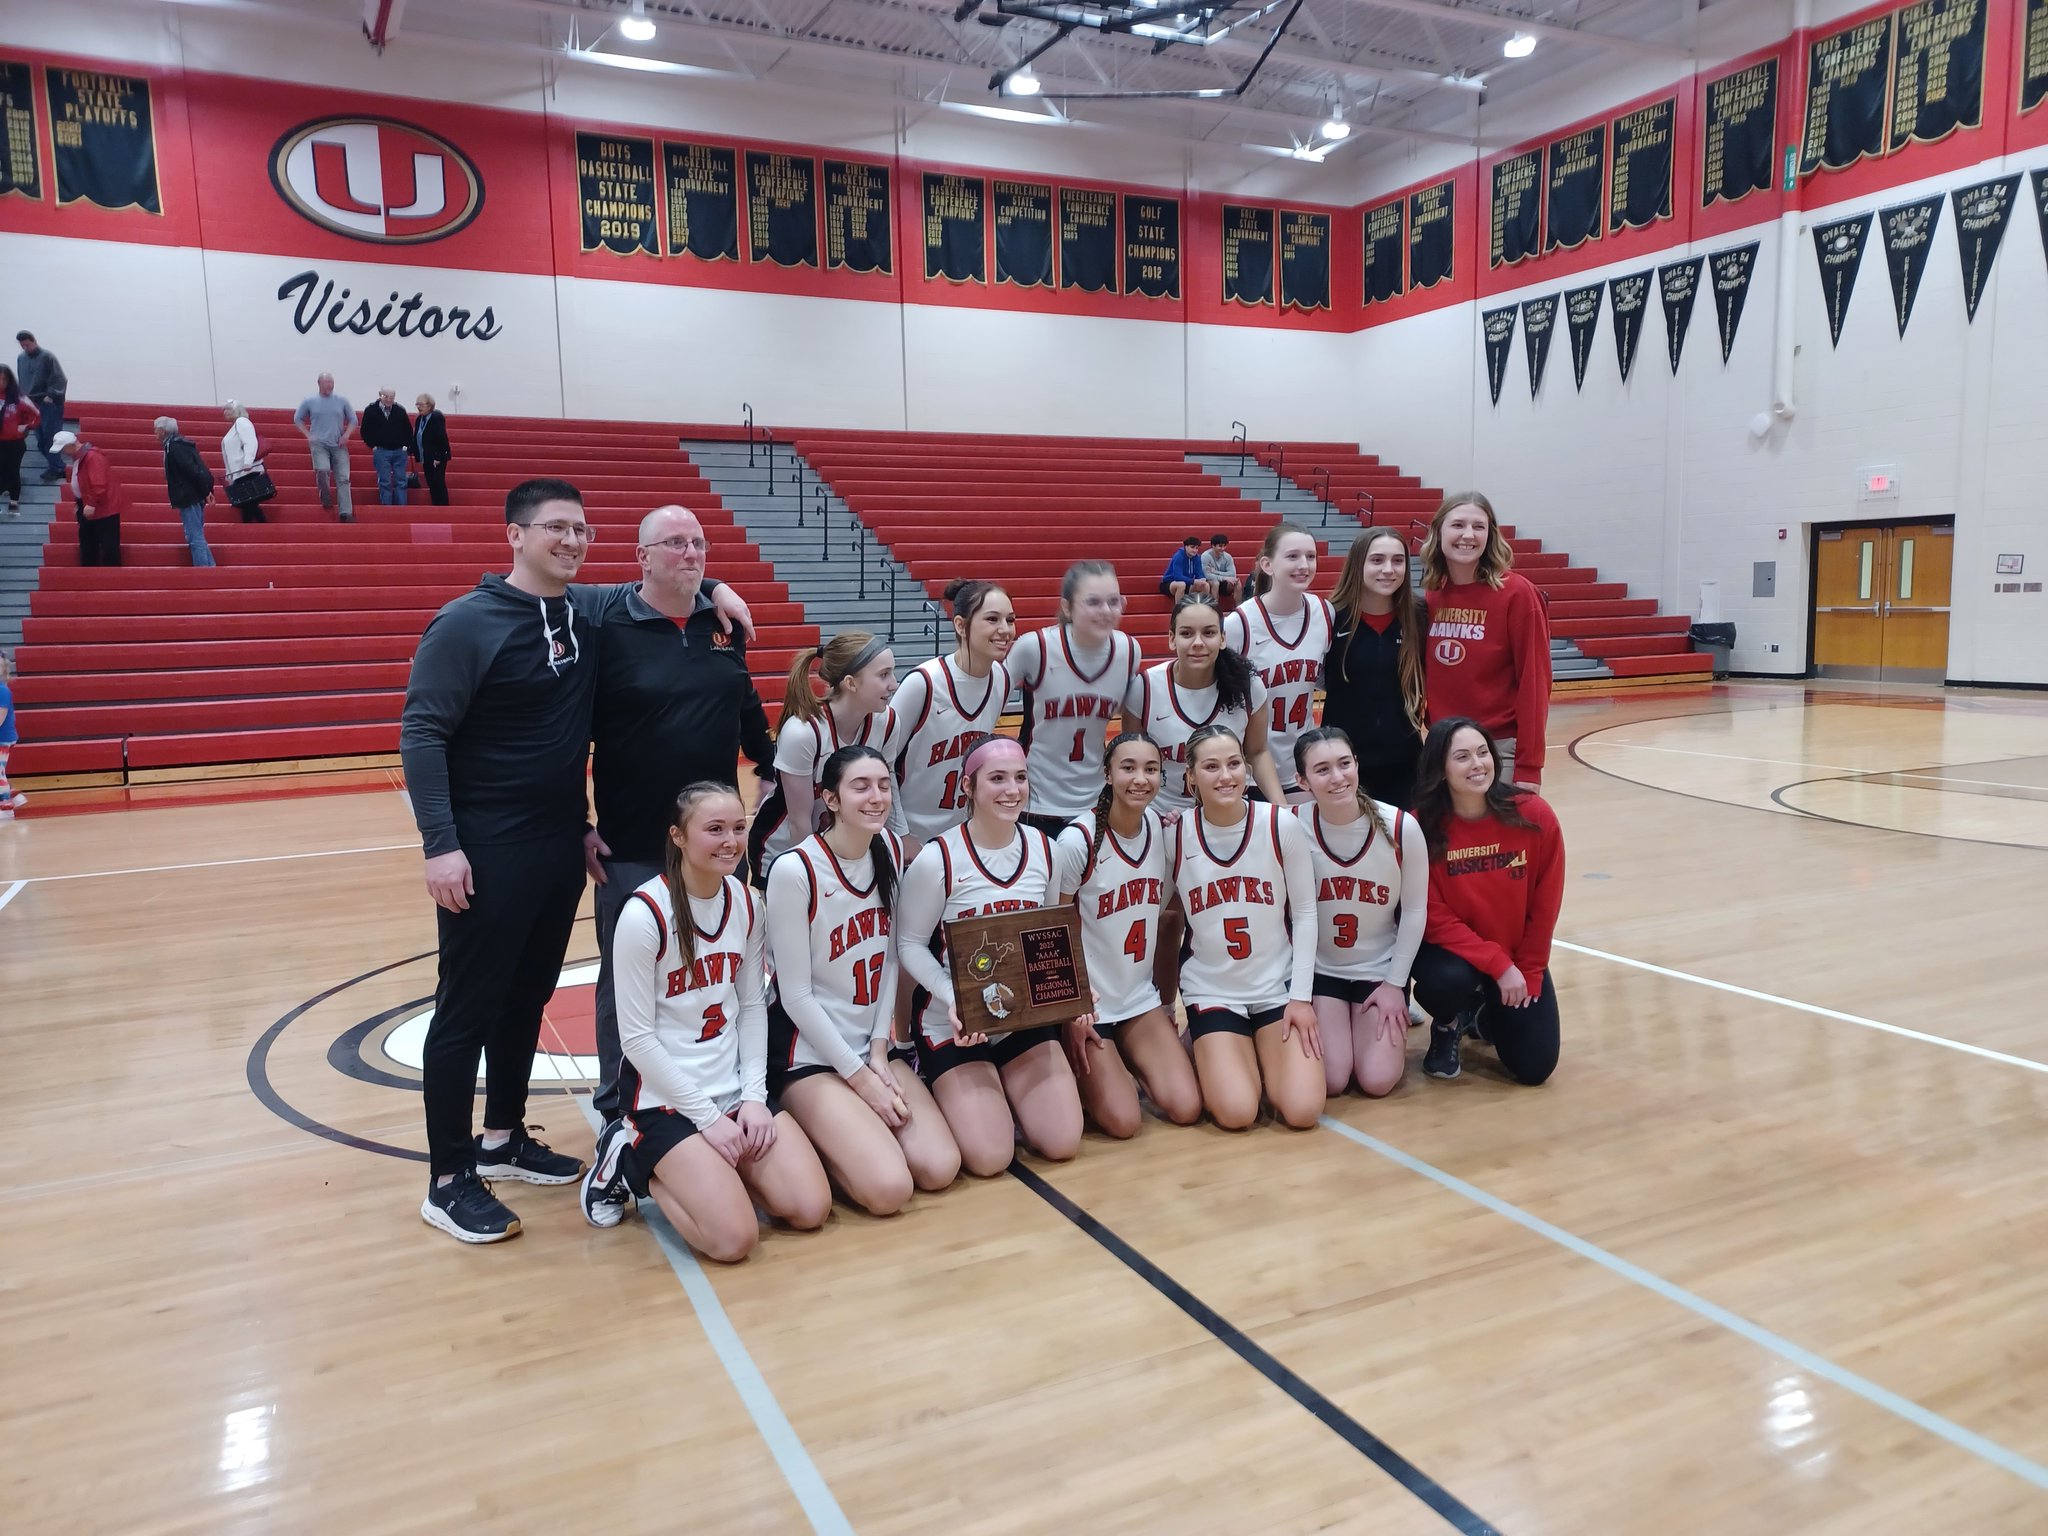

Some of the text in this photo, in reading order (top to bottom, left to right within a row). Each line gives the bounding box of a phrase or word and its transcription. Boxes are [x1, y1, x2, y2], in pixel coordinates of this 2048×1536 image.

[1903, 1, 1934, 26] GIRLS
[1906, 2, 1977, 40] CONFERENCE
[1817, 18, 1887, 55] BOYS TENNIS
[1911, 20, 1972, 51] CHAMPIONS
[1819, 35, 1881, 70] CONFERENCE
[1929, 41, 1950, 56] 2007
[1822, 52, 1877, 83] CHAMPIONS
[1928, 65, 1947, 79] 2012
[63, 71, 134, 96] FOOTBALL
[1714, 64, 1769, 93] VOLLEYBALL
[78, 89, 122, 108] STATE
[1714, 76, 1769, 110] CONFERENCE
[1926, 88, 1947, 104] 2022
[1717, 93, 1765, 121] CHAMPIONS
[66, 103, 138, 129] PLAYOFFS
[1620, 103, 1668, 132] VOLLEYBALL
[56, 120, 81, 132] 2020
[1632, 120, 1654, 138] STATE
[1560, 131, 1594, 153] SOFTBALL
[1620, 128, 1667, 155] TOURNAMENT
[1808, 136, 1826, 150] 2017
[601, 142, 630, 161] BOYS
[690, 145, 711, 158] BOYS
[1566, 146, 1587, 162] STATE
[673, 154, 728, 172] BASKETBALL
[770, 155, 791, 167] BOYS
[1502, 154, 1533, 174] SOFTBALL
[1555, 154, 1598, 178] TOURNAMENT
[581, 160, 652, 183] BASKETBALL
[689, 168, 714, 181] STATE
[754, 164, 807, 180] BASKETBALL
[846, 164, 868, 176] GIRLS
[1497, 164, 1536, 188] CONFERENCE
[675, 178, 728, 195] TOURNAMENT
[756, 175, 808, 191] CONFERENCE
[832, 173, 882, 188] BASKETBALL
[944, 175, 965, 187] GIRLS
[1500, 177, 1533, 196] CHAMPIONS
[599, 181, 637, 200] STATE
[760, 187, 805, 202] CHAMPIONS
[847, 187, 869, 198] STATE
[931, 184, 978, 199] BASKETBALL
[996, 182, 1049, 197] CHEERLEADING
[1063, 190, 1114, 205] CHEERLEADING
[1418, 184, 1445, 203] BASEBALL
[1961, 185, 1989, 207] OVAC
[586, 199, 652, 220] CHAMPIONS
[833, 194, 883, 211] TOURNAMENT
[931, 195, 978, 209] CONFERENCE
[1013, 196, 1034, 207] STATE
[1067, 201, 1110, 215] CONFERENCE
[1423, 198, 1440, 212] STATE
[935, 206, 975, 221] CHAMPIONS
[1001, 206, 1046, 220] COMPETITION
[1070, 213, 1107, 227] CHAMPIONS
[1141, 205, 1162, 220] GOLF
[1241, 208, 1256, 218] GOLF
[1298, 215, 1313, 224] GOLF
[1371, 204, 1396, 221] BASEBALL
[1415, 206, 1448, 225] TOURNAMENT
[1889, 207, 1915, 227] OVAC
[600, 220, 640, 240] 2019
[1240, 219, 1258, 229] STATE
[1287, 224, 1324, 236] CONFERENCE
[1368, 212, 1400, 232] CONFERENCE
[1962, 212, 2001, 232] CHAMPS
[1139, 226, 1165, 240] STATE
[1229, 228, 1268, 241] TOURNAMENT
[1292, 234, 1320, 246] CHAMPIONS
[1370, 224, 1397, 241] CHAMPIONS
[1822, 224, 1846, 242] OVAC
[1890, 233, 1927, 250] CHAMPS
[1128, 244, 1176, 261] CHAMPIONS
[1716, 253, 1737, 268] OVAC
[1824, 248, 1858, 264] CHAMPS
[1142, 265, 1162, 279] 2012
[1664, 266, 1682, 280] OVAC
[1616, 278, 1634, 293] OVAC
[1718, 275, 1747, 289] CHAMPS
[1570, 291, 1587, 304] OVAC
[1666, 288, 1691, 302] CHAMPS
[278, 269, 503, 341] Visitors
[1527, 301, 1542, 314] OVAC
[1616, 299, 1642, 311] CHAMPS
[1485, 312, 1498, 327] OVAC
[1572, 311, 1594, 323] CHAMPS
[1528, 320, 1549, 332] CHAMPS
[1488, 330, 1508, 342] CHAMPS
[1429, 623, 1485, 640] HAWKS
[1260, 659, 1324, 689] HAWK
[1272, 692, 1309, 732] 14
[1069, 728, 1086, 762] 1
[1447, 843, 1500, 861] UNIVERSITY
[1448, 849, 1528, 876] BASKETBALL
[1188, 876, 1275, 916] HAWKS
[1318, 876, 1389, 905] AWKS
[829, 907, 891, 962] HAWK
[1028, 930, 1062, 941] WVSSAC
[1223, 917, 1252, 960] 5
[1333, 914, 1358, 948] 3
[1039, 941, 1055, 949] 2025
[1124, 918, 1147, 963] 4
[1036, 950, 1060, 960] "AAAA"
[1028, 957, 1072, 972] BASKETBALL
[853, 950, 885, 1007] 12
[1035, 979, 1072, 992] REGIONAL
[1035, 987, 1075, 1000] CHAMPION
[695, 1001, 727, 1043] 2
